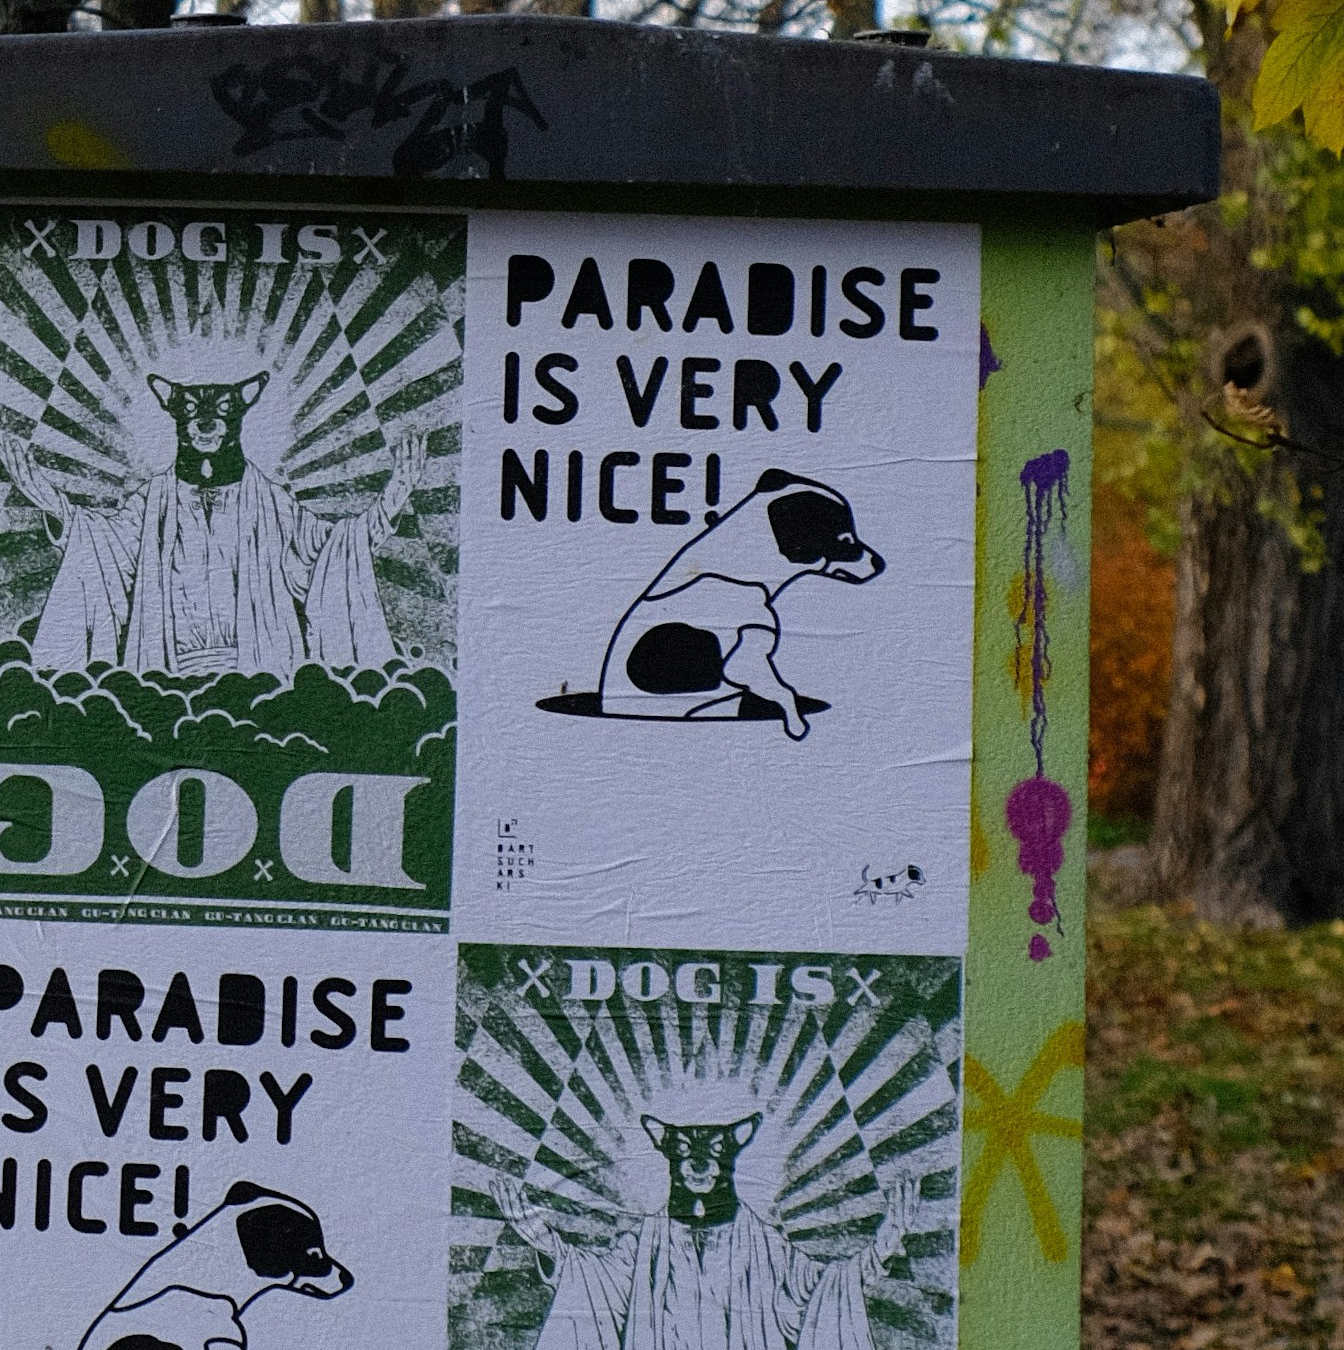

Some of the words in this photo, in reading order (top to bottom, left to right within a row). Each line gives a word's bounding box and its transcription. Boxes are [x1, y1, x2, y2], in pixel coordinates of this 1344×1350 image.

[69, 218, 228, 263] DOG
[258, 223, 344, 264] IS
[505, 254, 943, 342] PARADISE
[503, 351, 579, 426] IS
[617, 356, 843, 432] VERY
[501, 447, 722, 527] NICE!
[563, 959, 722, 1004] DOG
[748, 963, 835, 1006] IS
[85, 1064, 313, 1145] VERY
